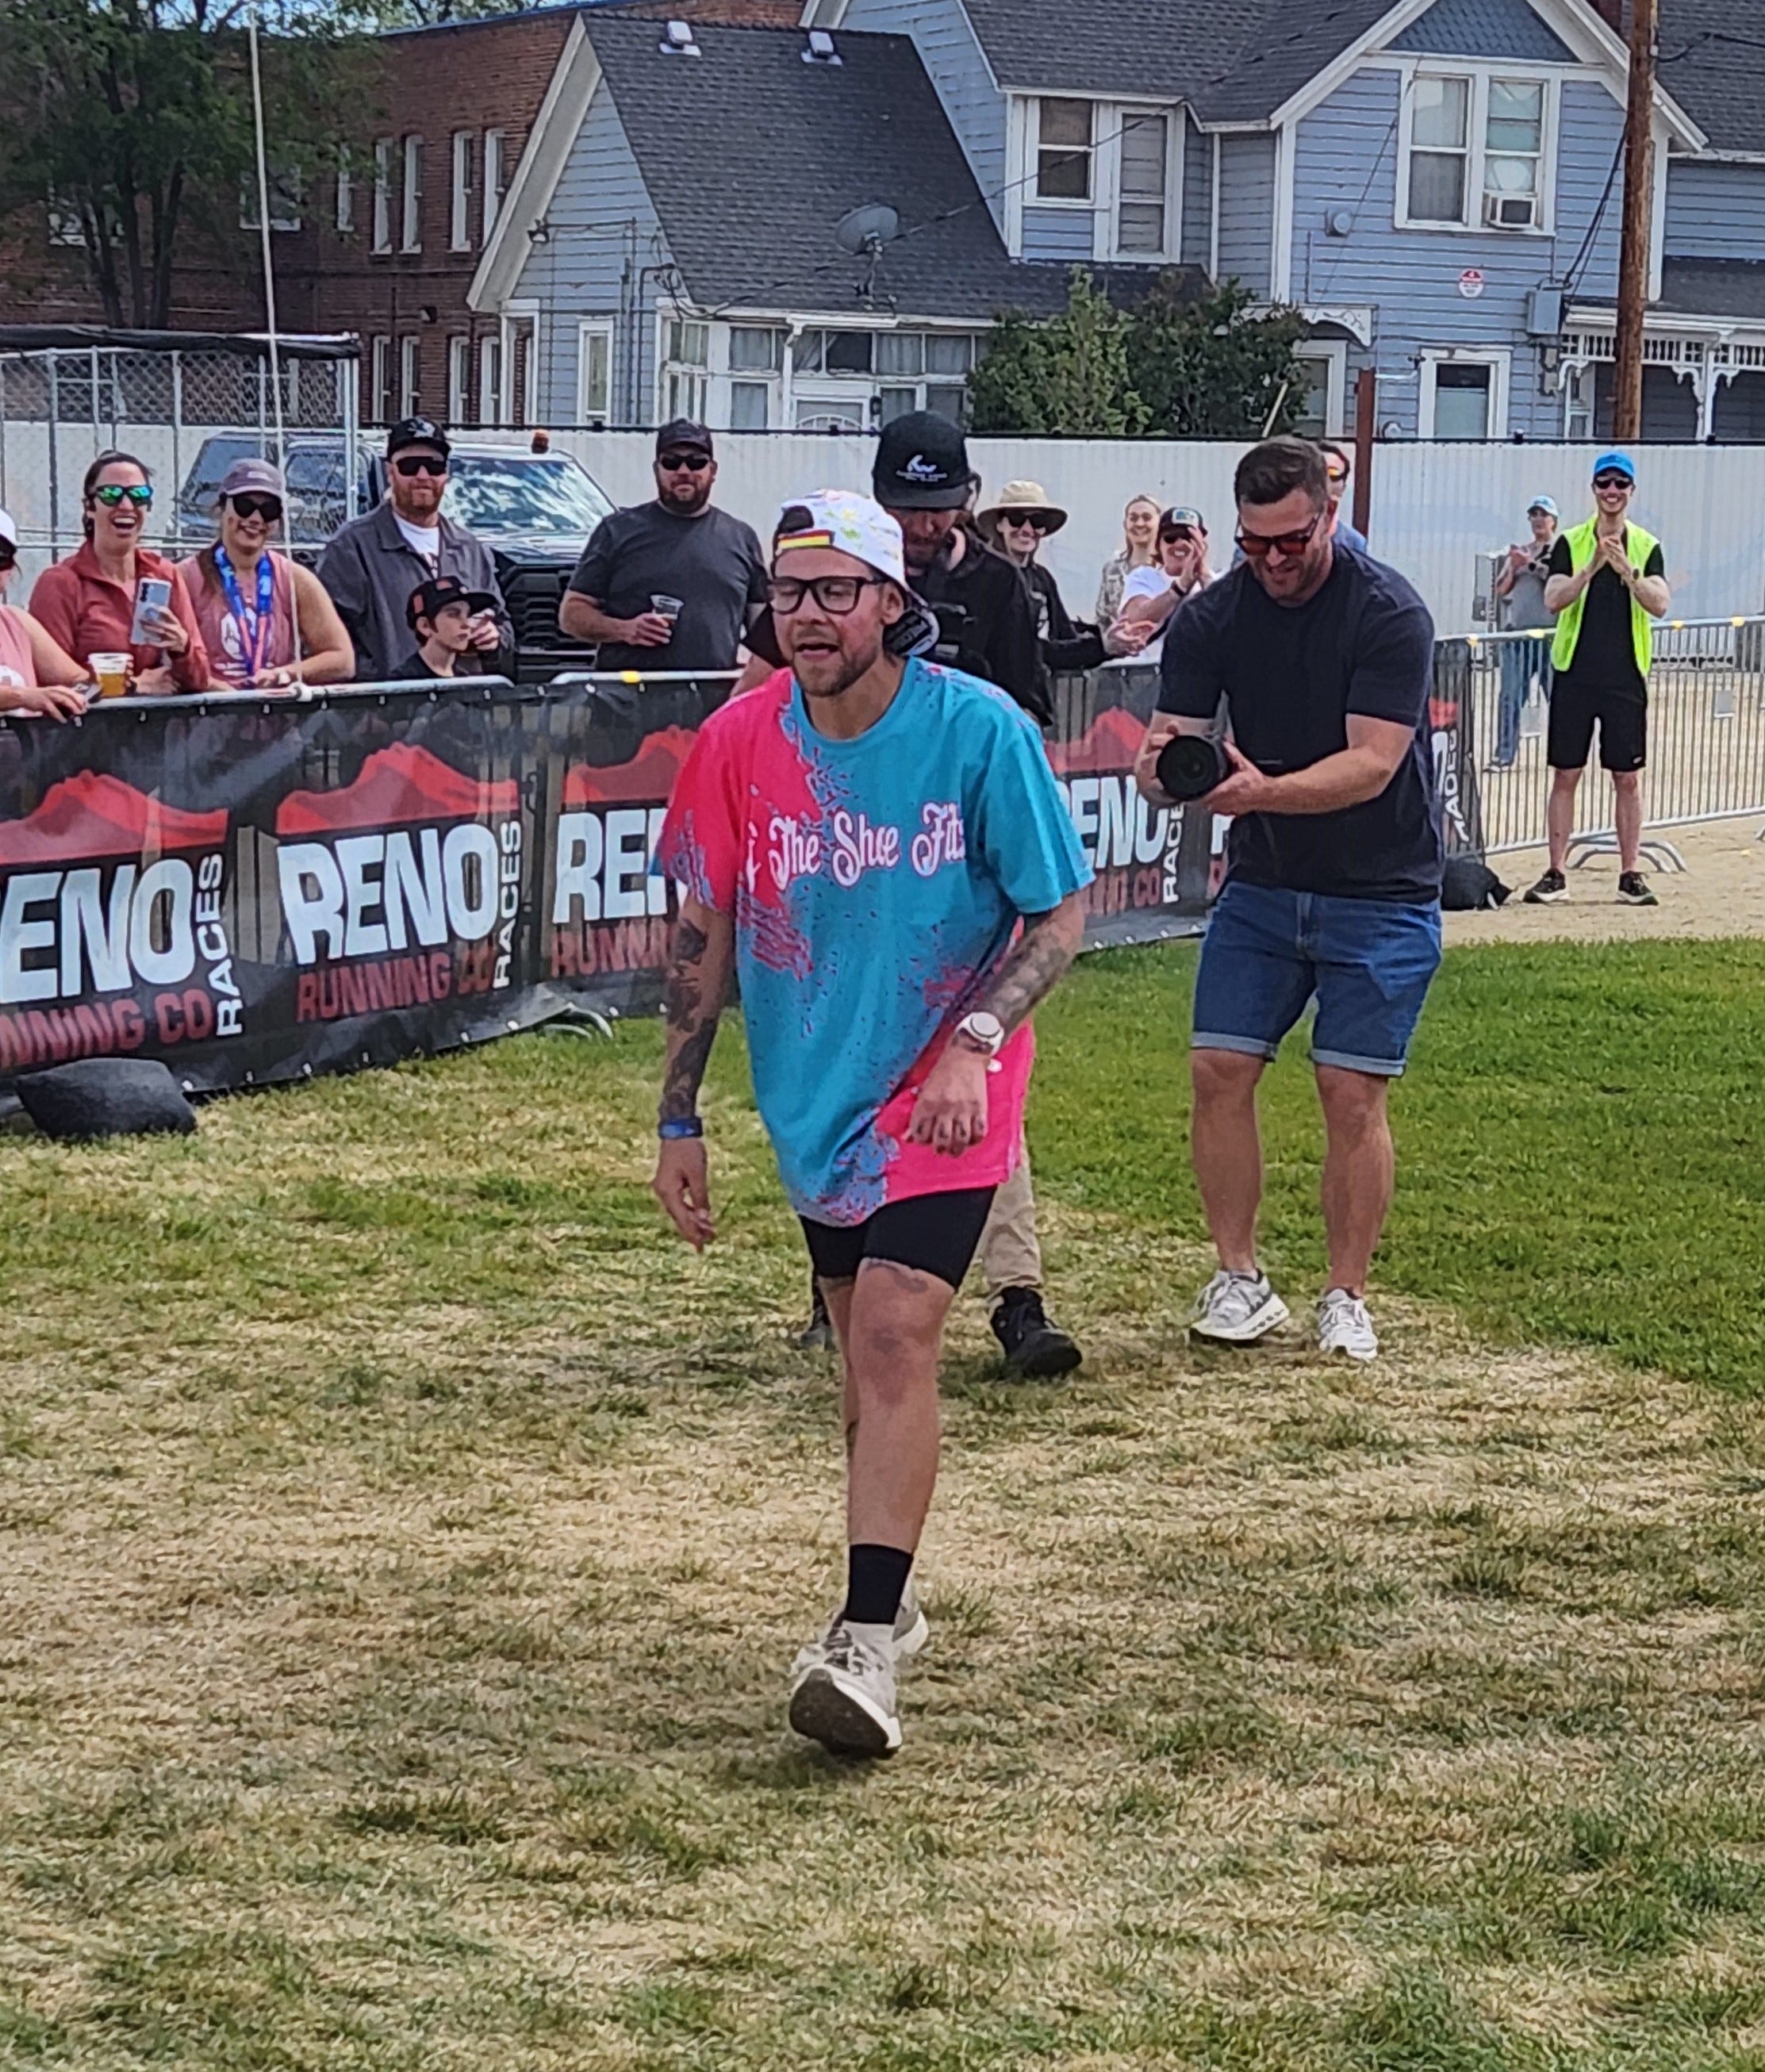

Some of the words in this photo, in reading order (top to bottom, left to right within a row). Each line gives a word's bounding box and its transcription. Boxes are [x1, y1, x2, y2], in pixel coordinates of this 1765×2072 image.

[553, 808, 689, 923] RE
[768, 815, 822, 891] The
[833, 810, 900, 886] Shoe
[1057, 774, 1169, 869] ENO
[1163, 803, 1185, 904] RACE
[0, 859, 195, 1003] ENO
[196, 854, 243, 1036] RACES
[278, 823, 498, 965] RENO
[492, 821, 520, 989] RACES
[0, 998, 146, 1069] NNING
[154, 988, 213, 1044] CO
[297, 952, 452, 1023] RUNNING
